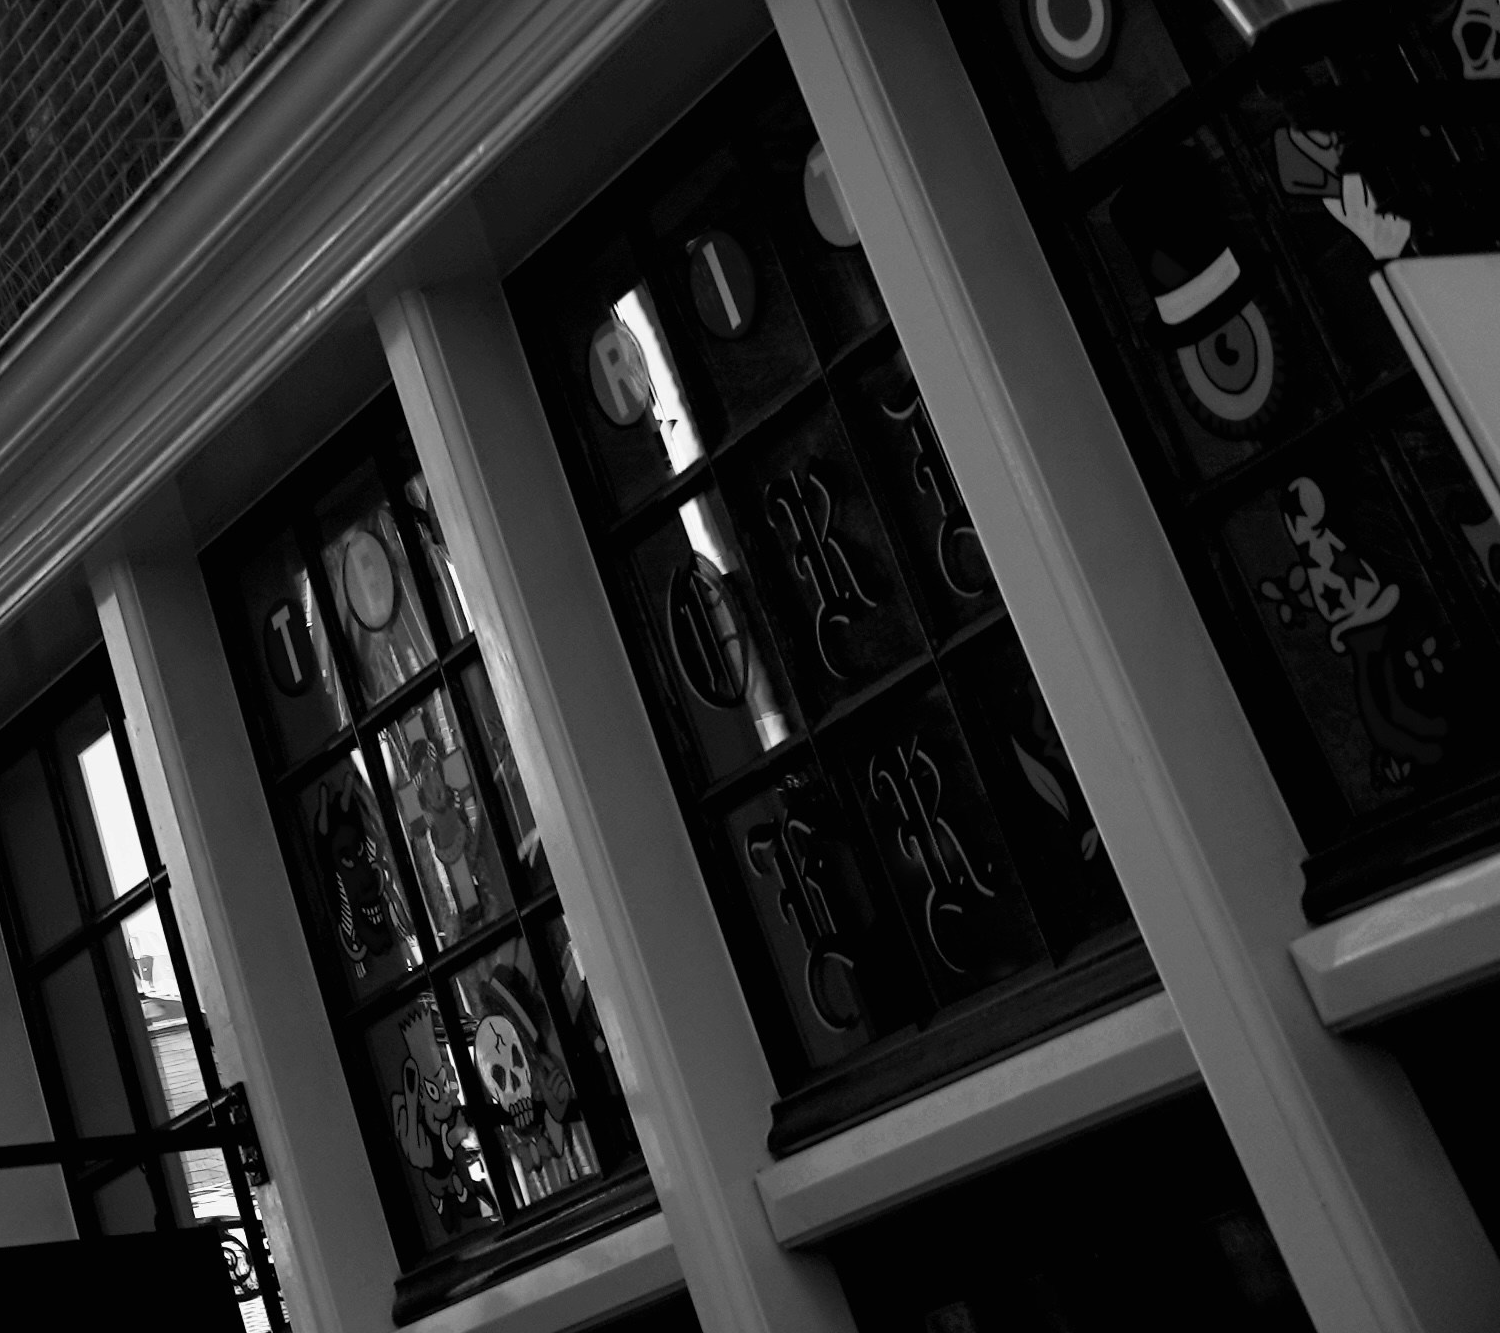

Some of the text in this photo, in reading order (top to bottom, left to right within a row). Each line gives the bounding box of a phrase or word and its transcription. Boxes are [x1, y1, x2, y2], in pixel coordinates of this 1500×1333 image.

[270, 604, 303, 684] T
[594, 329, 647, 420] R
[701, 240, 742, 331] I
